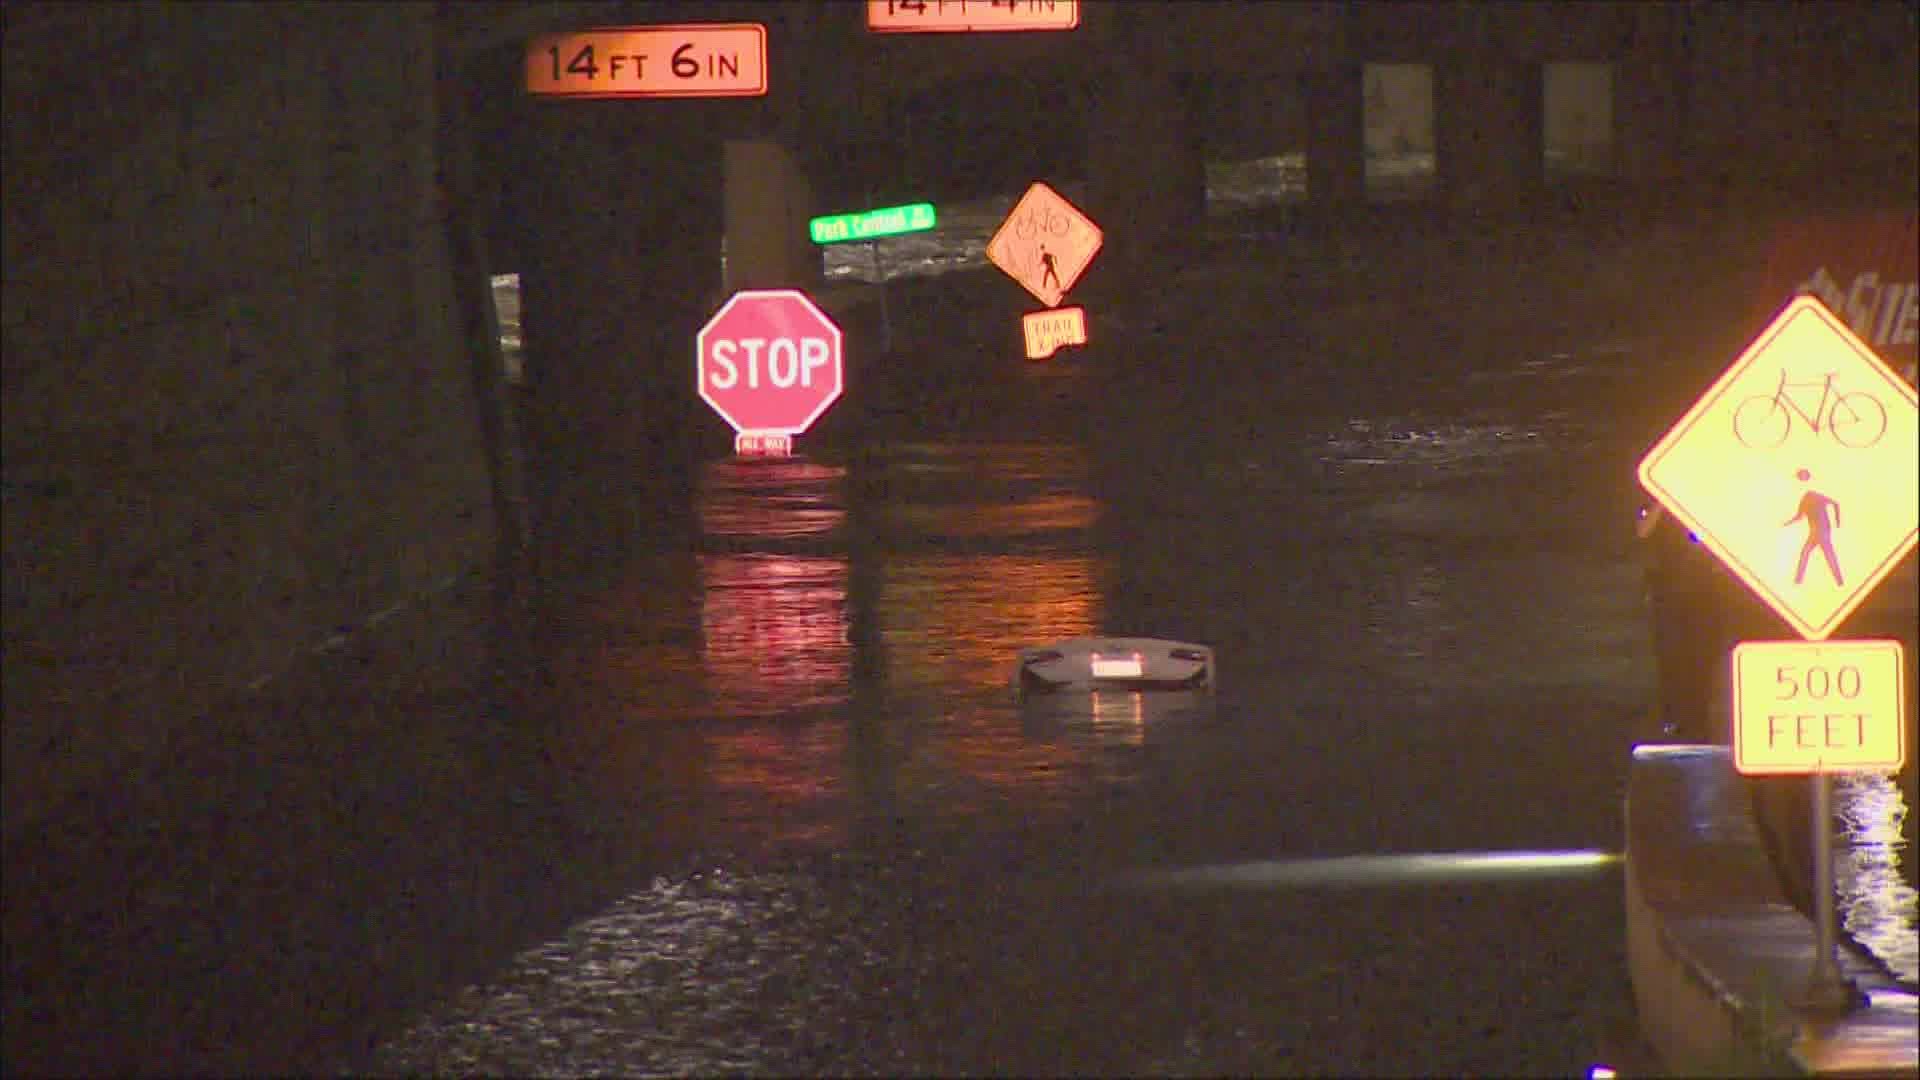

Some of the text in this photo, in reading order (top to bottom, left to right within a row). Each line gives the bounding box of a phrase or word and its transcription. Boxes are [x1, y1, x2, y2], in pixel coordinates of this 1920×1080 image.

[547, 42, 739, 81] 14 FT 6 IN
[709, 336, 830, 390] STOP
[1775, 665, 1861, 701] 500
[1767, 713, 1873, 750] FEET
